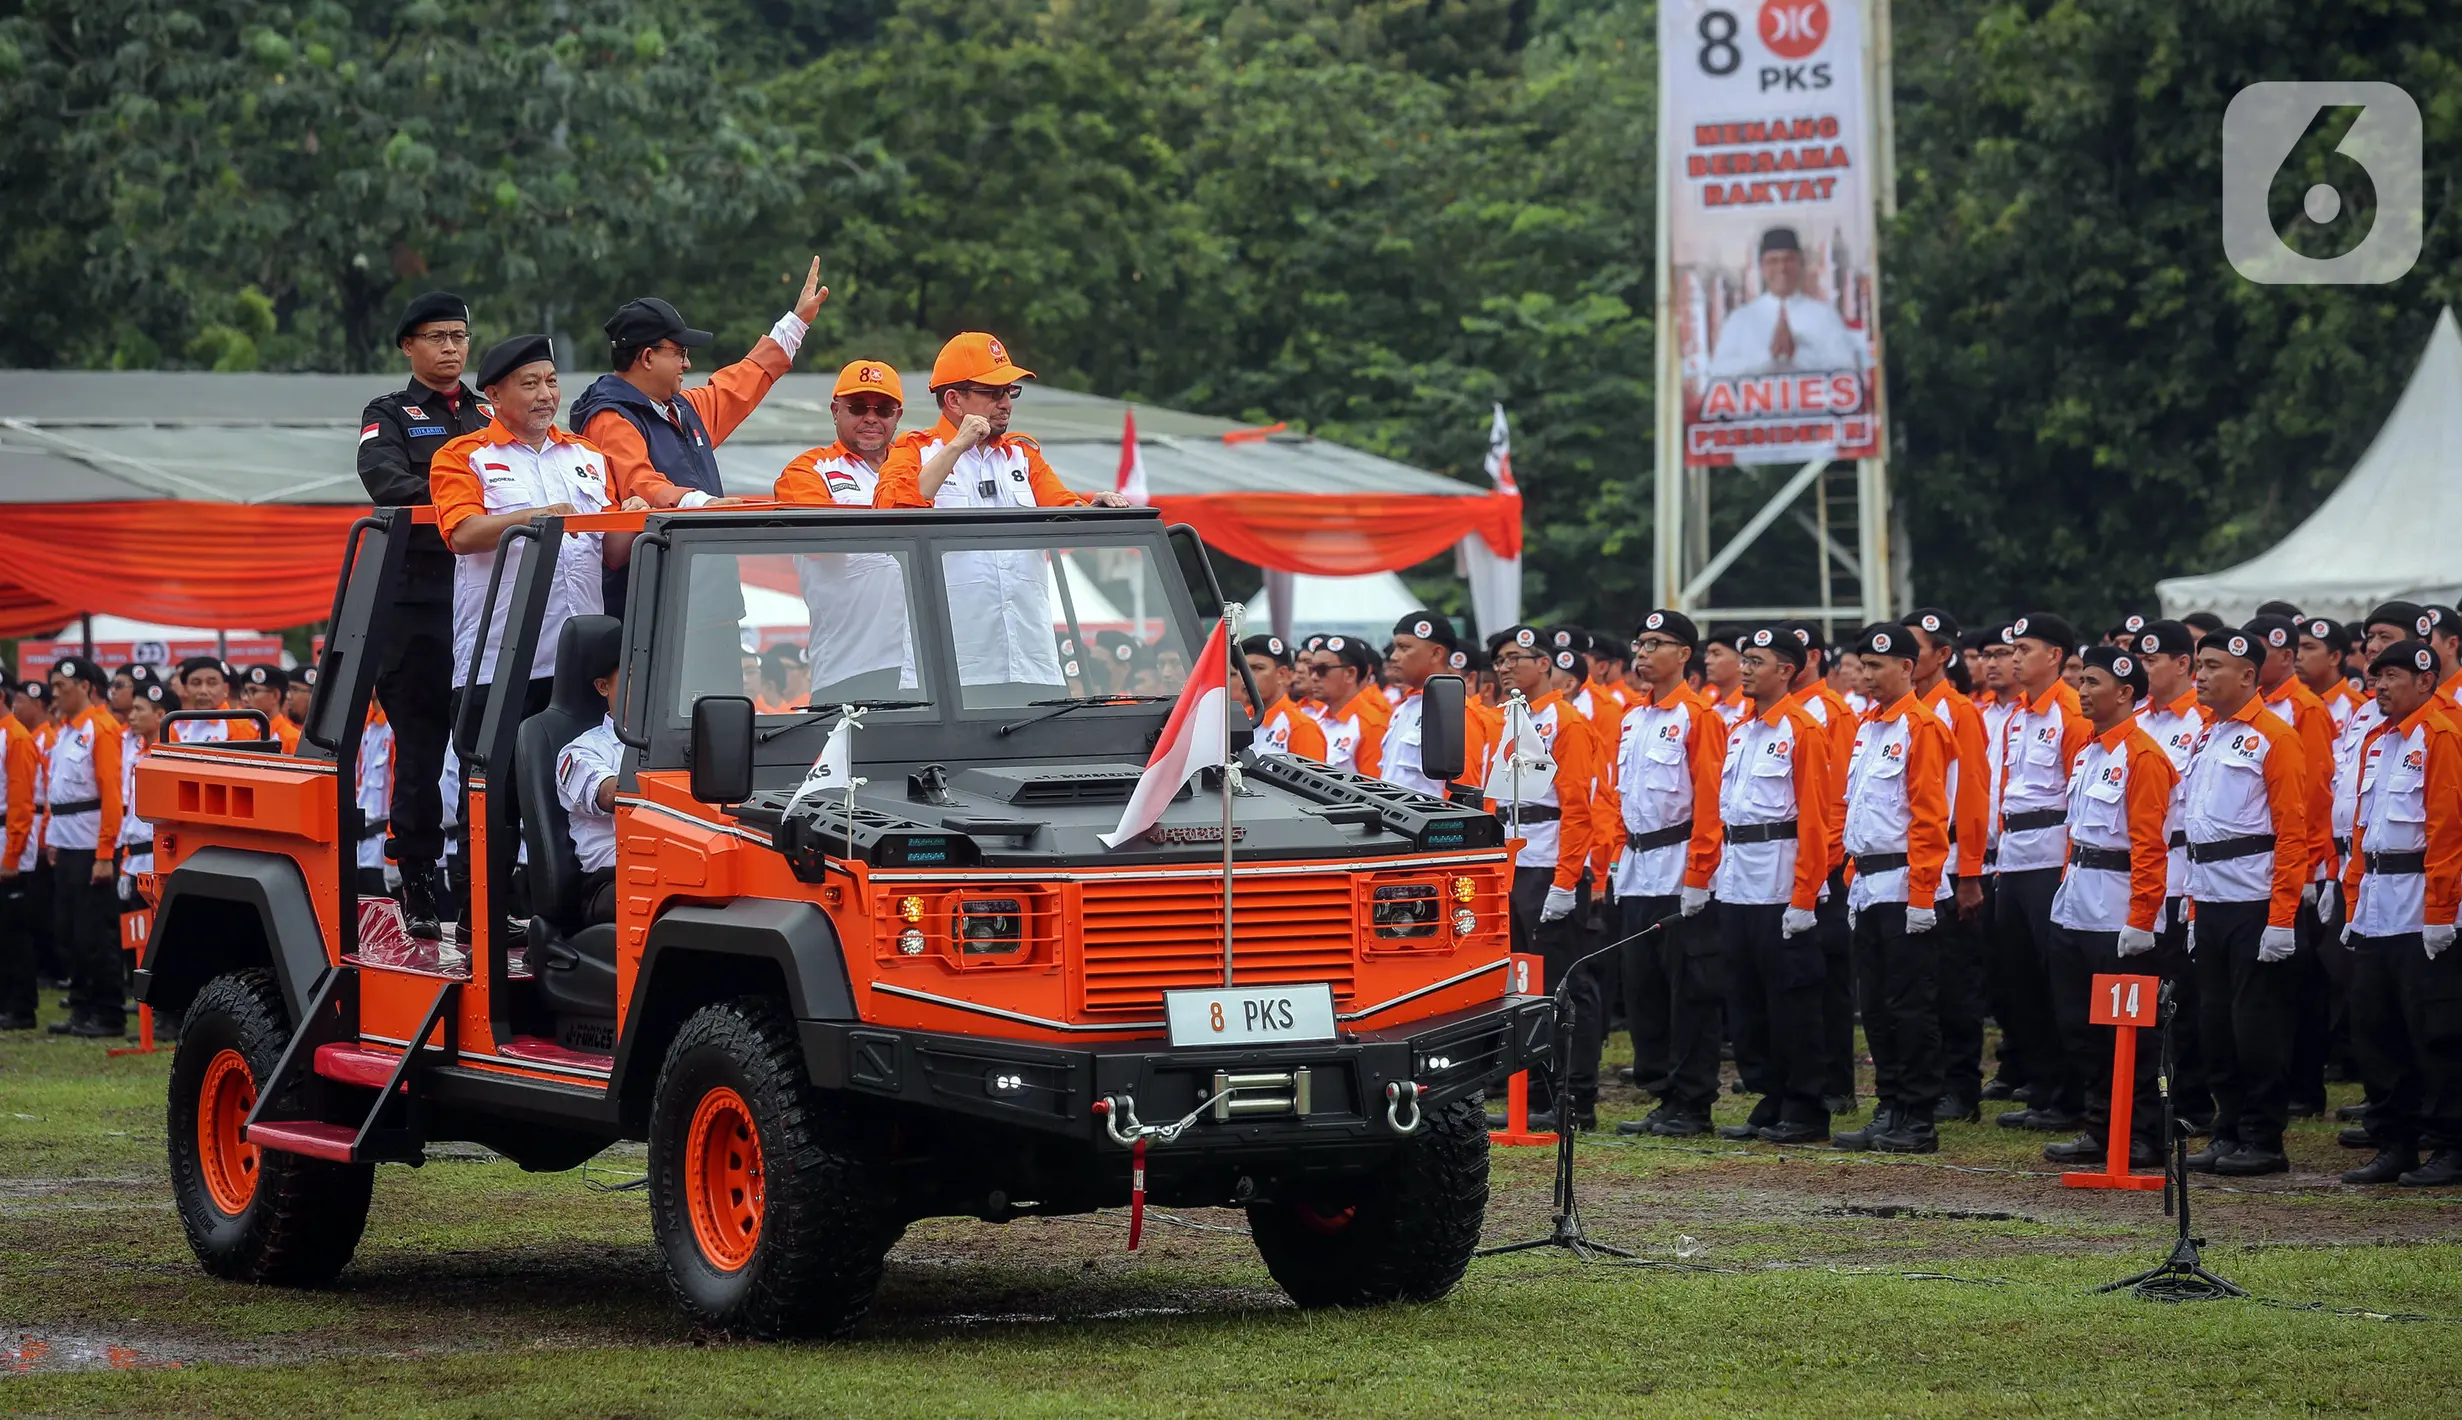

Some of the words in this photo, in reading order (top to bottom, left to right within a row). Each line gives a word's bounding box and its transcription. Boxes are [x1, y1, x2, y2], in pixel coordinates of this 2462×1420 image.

[1697, 10, 1741, 76] 8
[1759, 63, 1833, 93] PKS
[1694, 116, 1839, 147] MENANG
[1687, 146, 1849, 177] BERSAMA
[1704, 177, 1837, 207] RAKYAT
[994, 355, 1008, 364] PKS
[859, 367, 870, 382] 8
[1705, 374, 1858, 417] ANIES
[575, 466, 588, 478] 8
[1011, 470, 1025, 482] 8
[1660, 726, 1667, 738] 8
[2038, 728, 2046, 740] 8
[2170, 734, 2179, 746] 8
[2232, 734, 2244, 750] 8
[1767, 742, 1776, 754] 8
[1882, 745, 1890, 757] 8
[2238, 750, 2254, 758] PKS
[2402, 754, 2410, 768] 8
[2408, 764, 2422, 772] PKS
[808, 764, 832, 782] KS
[2102, 768, 2110, 781] 8
[129, 915, 145, 942] 10
[1517, 960, 1528, 993] 3
[2110, 983, 2139, 1018] 14
[1210, 1002, 1225, 1031] 8
[1243, 999, 1294, 1031] PKS
[566, 1022, 613, 1050] J-FORCES
